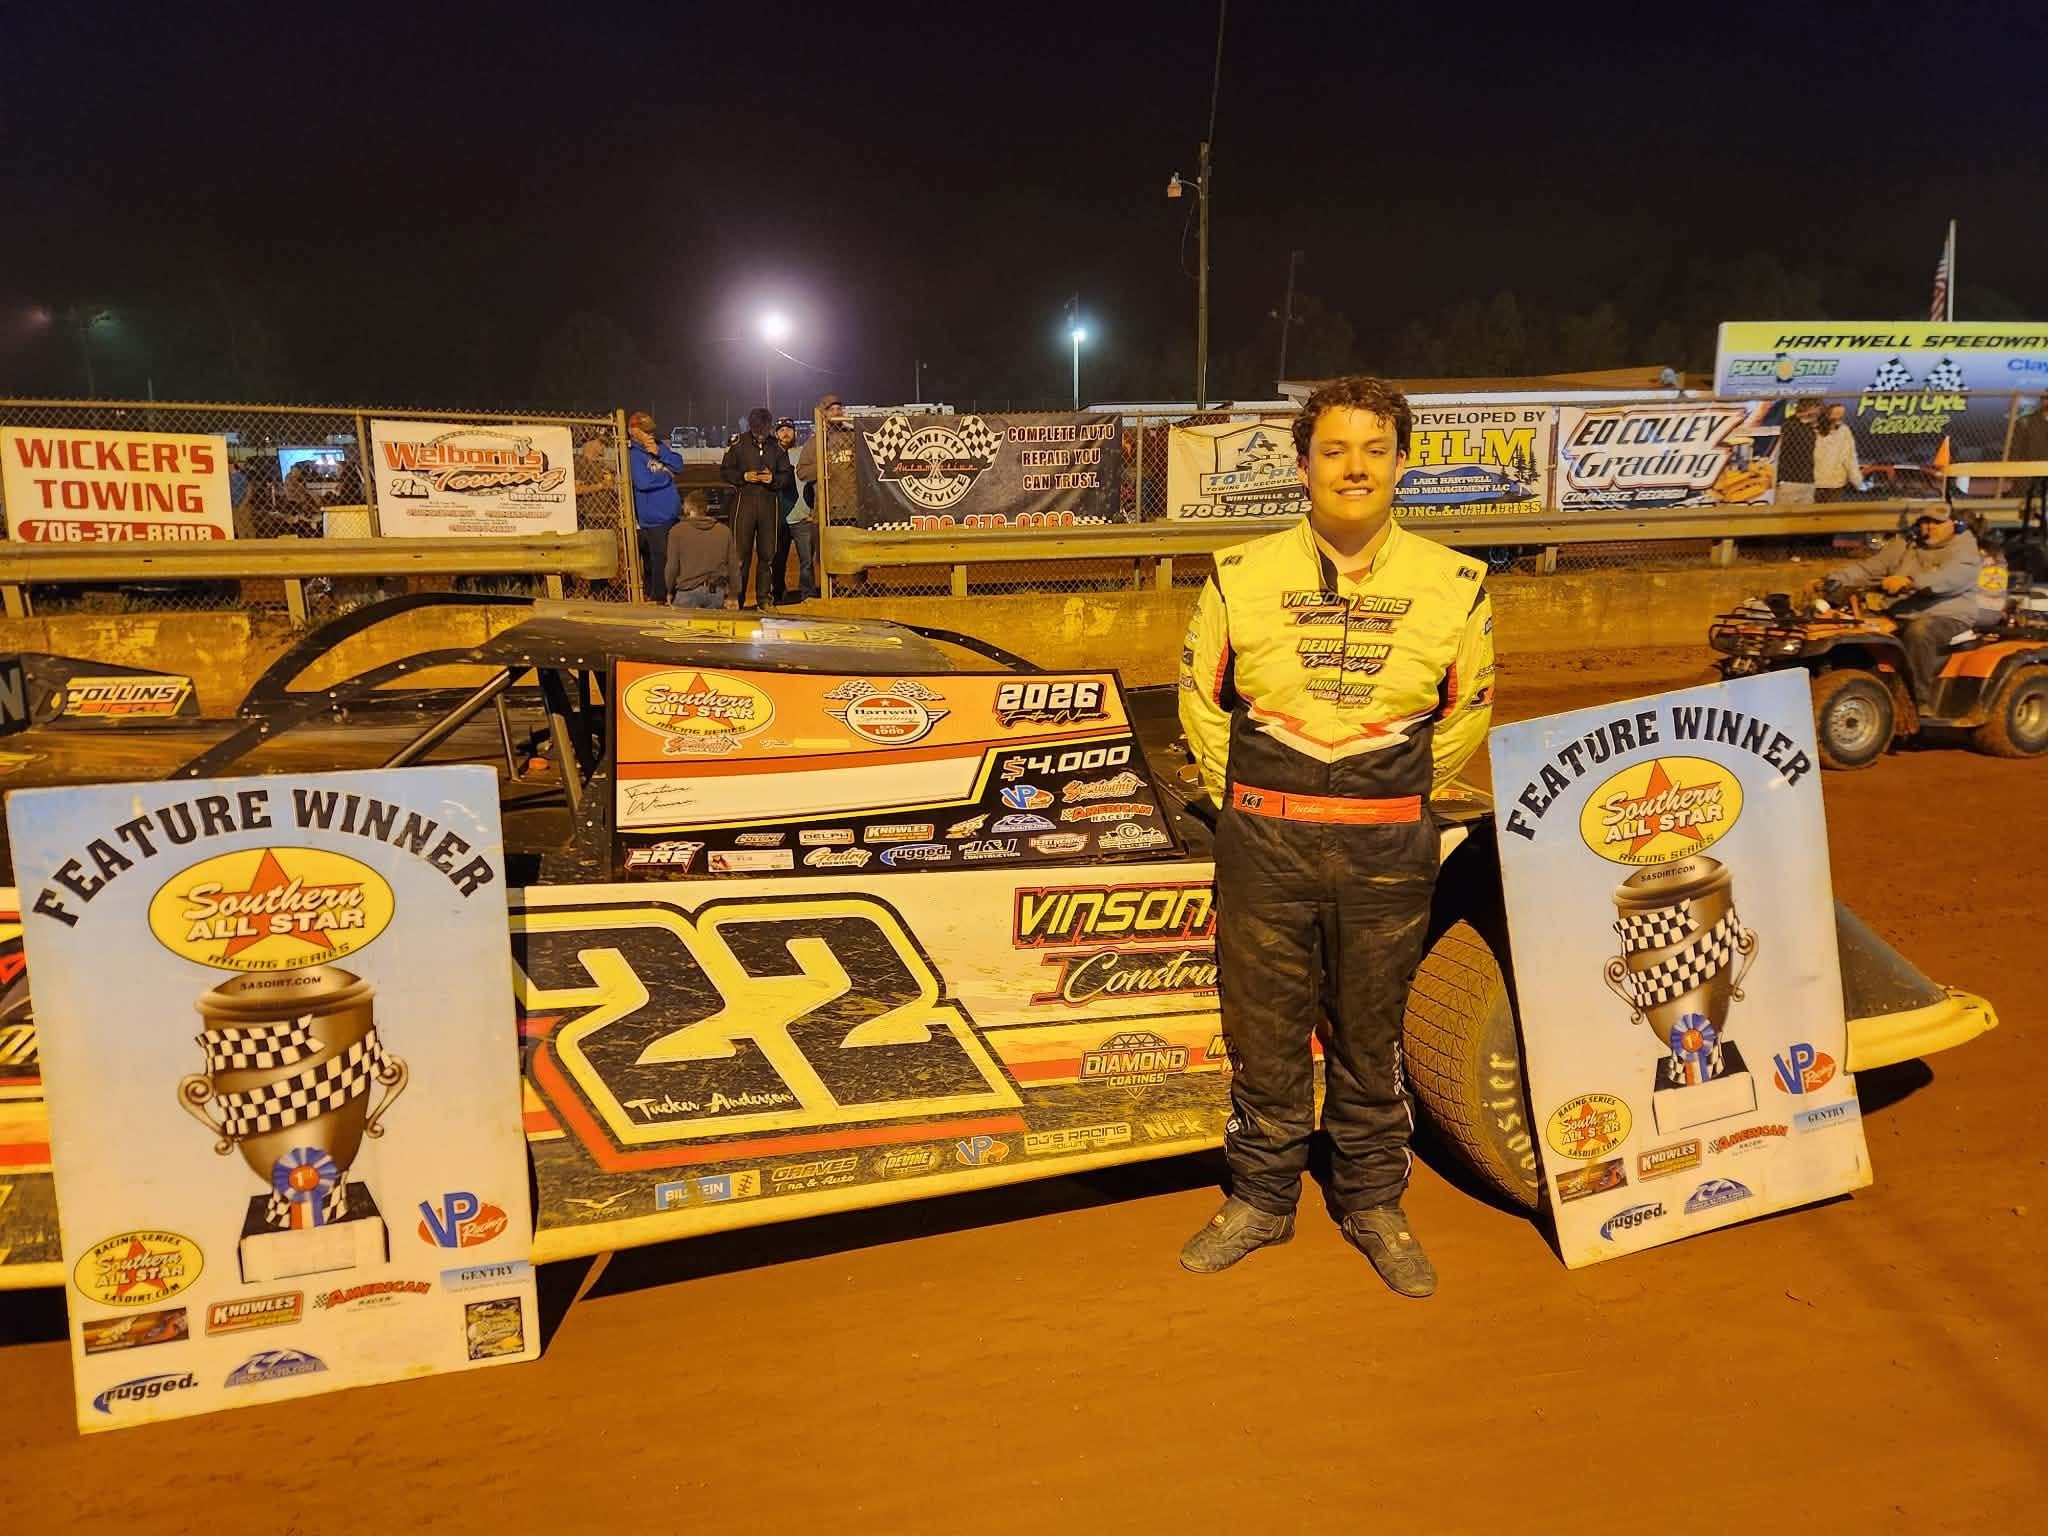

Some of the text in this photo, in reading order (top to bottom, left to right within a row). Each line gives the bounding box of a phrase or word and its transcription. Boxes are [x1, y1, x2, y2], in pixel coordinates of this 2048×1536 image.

[1775, 334, 2048, 348] HARTWELL SPEEDWAY
[1411, 411, 1546, 425] DEVELOPED BY
[1573, 415, 1729, 446] ED COLLEY
[907, 432, 963, 454] SMITH
[1007, 423, 1115, 442] COMPLETE AUTO
[15, 438, 214, 474] WICKER'S
[383, 440, 544, 473] Welborn's
[1022, 448, 1101, 466] REPAIR YOU
[1574, 450, 1720, 479] Grading
[434, 467, 567, 492] Towing
[1023, 472, 1101, 490] CAN TRUST.
[1269, 467, 1298, 480] PR
[1413, 476, 1492, 486] LAKE HARTWELL
[34, 479, 204, 513] TOWING
[903, 474, 969, 502] SERVICE
[1395, 487, 1420, 495] LAND
[1422, 485, 1492, 495] MANAGEMENT
[1460, 501, 1542, 516] UTILITIES
[1360, 596, 1411, 614] SIMS
[67, 684, 178, 706] COLLINS
[647, 684, 755, 708] Southern
[997, 682, 1102, 711] 2026
[647, 703, 755, 720] ALL STAR
[855, 708, 919, 717] Hartwell
[655, 721, 747, 737] RACING SERIES
[1505, 706, 1812, 842] FEATURE WINNER
[624, 782, 692, 800] Feature
[1001, 785, 1038, 809] VP
[626, 799, 698, 817] Winner
[1072, 803, 1154, 819] AMERICAN
[1602, 781, 1723, 827] Southern
[1091, 813, 1132, 823] RACER
[1604, 807, 1724, 846] ALL STAR
[869, 825, 929, 838] KNOWLES
[32, 788, 494, 928] FEATURE WINNER
[1618, 833, 1715, 864] RACING SERIES
[182, 877, 365, 923] Southern
[1021, 889, 1213, 936] VINSON
[187, 909, 366, 942] ALL STAR
[207, 943, 351, 971] RACING SERIES
[1063, 950, 1218, 1003] Constru
[509, 902, 1015, 1138] 22
[1084, 1050, 1187, 1075] DIAMOND
[1772, 1042, 1816, 1095] VP
[1109, 1072, 1166, 1088] COATINGS
[624, 1090, 795, 1118] Tucker Anderson
[1557, 1095, 1617, 1119] RACING SERIES
[1807, 1106, 1846, 1123] GENTRY
[1068, 1125, 1128, 1141] RACING
[1561, 1121, 1621, 1146] ALL SAR
[957, 1136, 994, 1164] VP
[1641, 1144, 1697, 1171] KNOWLES
[418, 1191, 479, 1249] VP
[461, 1216, 504, 1243] Racing
[94, 1232, 182, 1258] RACING SERIES
[100, 1249, 183, 1273] Southern
[461, 1264, 515, 1281] GENTRY
[96, 1264, 185, 1289] ALL STAR
[328, 1280, 431, 1309] AMERICAN
[214, 1296, 296, 1324] KNOWLES
